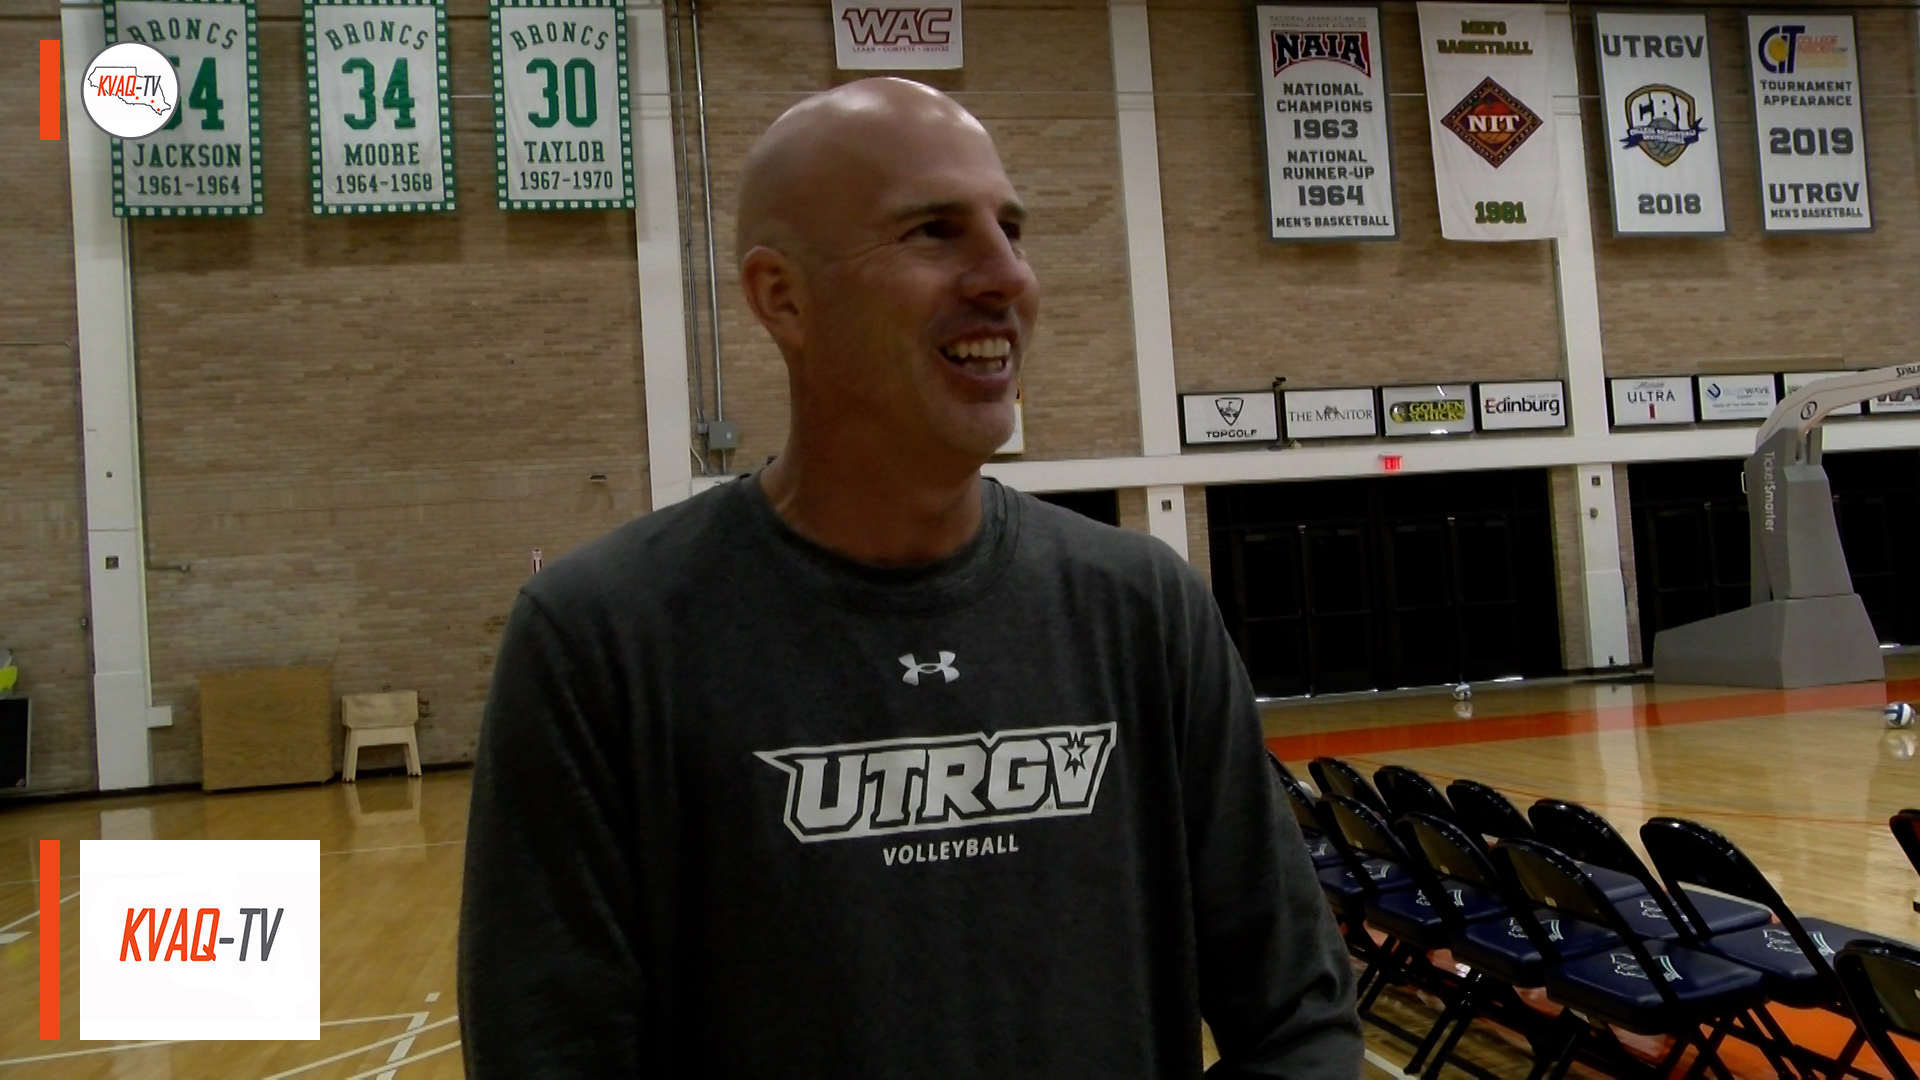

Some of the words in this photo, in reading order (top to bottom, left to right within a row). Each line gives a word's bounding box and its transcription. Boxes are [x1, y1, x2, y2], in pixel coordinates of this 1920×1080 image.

[126, 17, 238, 50] BRONCS
[325, 20, 429, 51] BRONCS
[510, 21, 609, 51] BRONCS
[842, 8, 953, 45] WAC
[1271, 32, 1370, 75] NAIA
[1601, 34, 1704, 58] UTRGV
[341, 57, 416, 130] 34
[526, 57, 598, 128] 30
[1283, 82, 1363, 96] NATIONAL
[1760, 79, 1853, 92] TOURNAMENT
[1276, 100, 1373, 113] CHAMPIONS
[1630, 91, 1690, 131] CBI
[1763, 95, 1853, 106] APPEARANCE
[1293, 119, 1359, 140] 1963
[1466, 114, 1520, 133] NIT
[523, 141, 605, 163] TAYLOR
[1769, 127, 1854, 156] 2019
[132, 143, 242, 168] JACKSON
[344, 142, 420, 167] MOORE
[1287, 150, 1367, 163] NATIONAL
[336, 173, 433, 194] 1964-1968
[520, 171, 613, 190] 1967-1970
[1283, 167, 1375, 180] RUNNER-UP
[137, 175, 241, 196] 1961-1964
[1298, 185, 1365, 206] 1964
[1769, 182, 1860, 204] UTRGV
[1638, 193, 1702, 214] 2018
[1801, 207, 1864, 219] BASKETBALL
[1314, 215, 1390, 228] BASKETBALL
[1409, 400, 1464, 412] GOLDEN
[1484, 396, 1560, 416] Edinburg
[1627, 390, 1676, 403] ULTRA
[1288, 410, 1312, 423] THE
[1315, 409, 1373, 422] MONITOR
[1205, 429, 1258, 439] TOPGOLF
[1763, 451, 1777, 532] TicketSmarter
[782, 730, 1110, 835] UTRGV
[882, 833, 1019, 867] VOLLEYBALL
